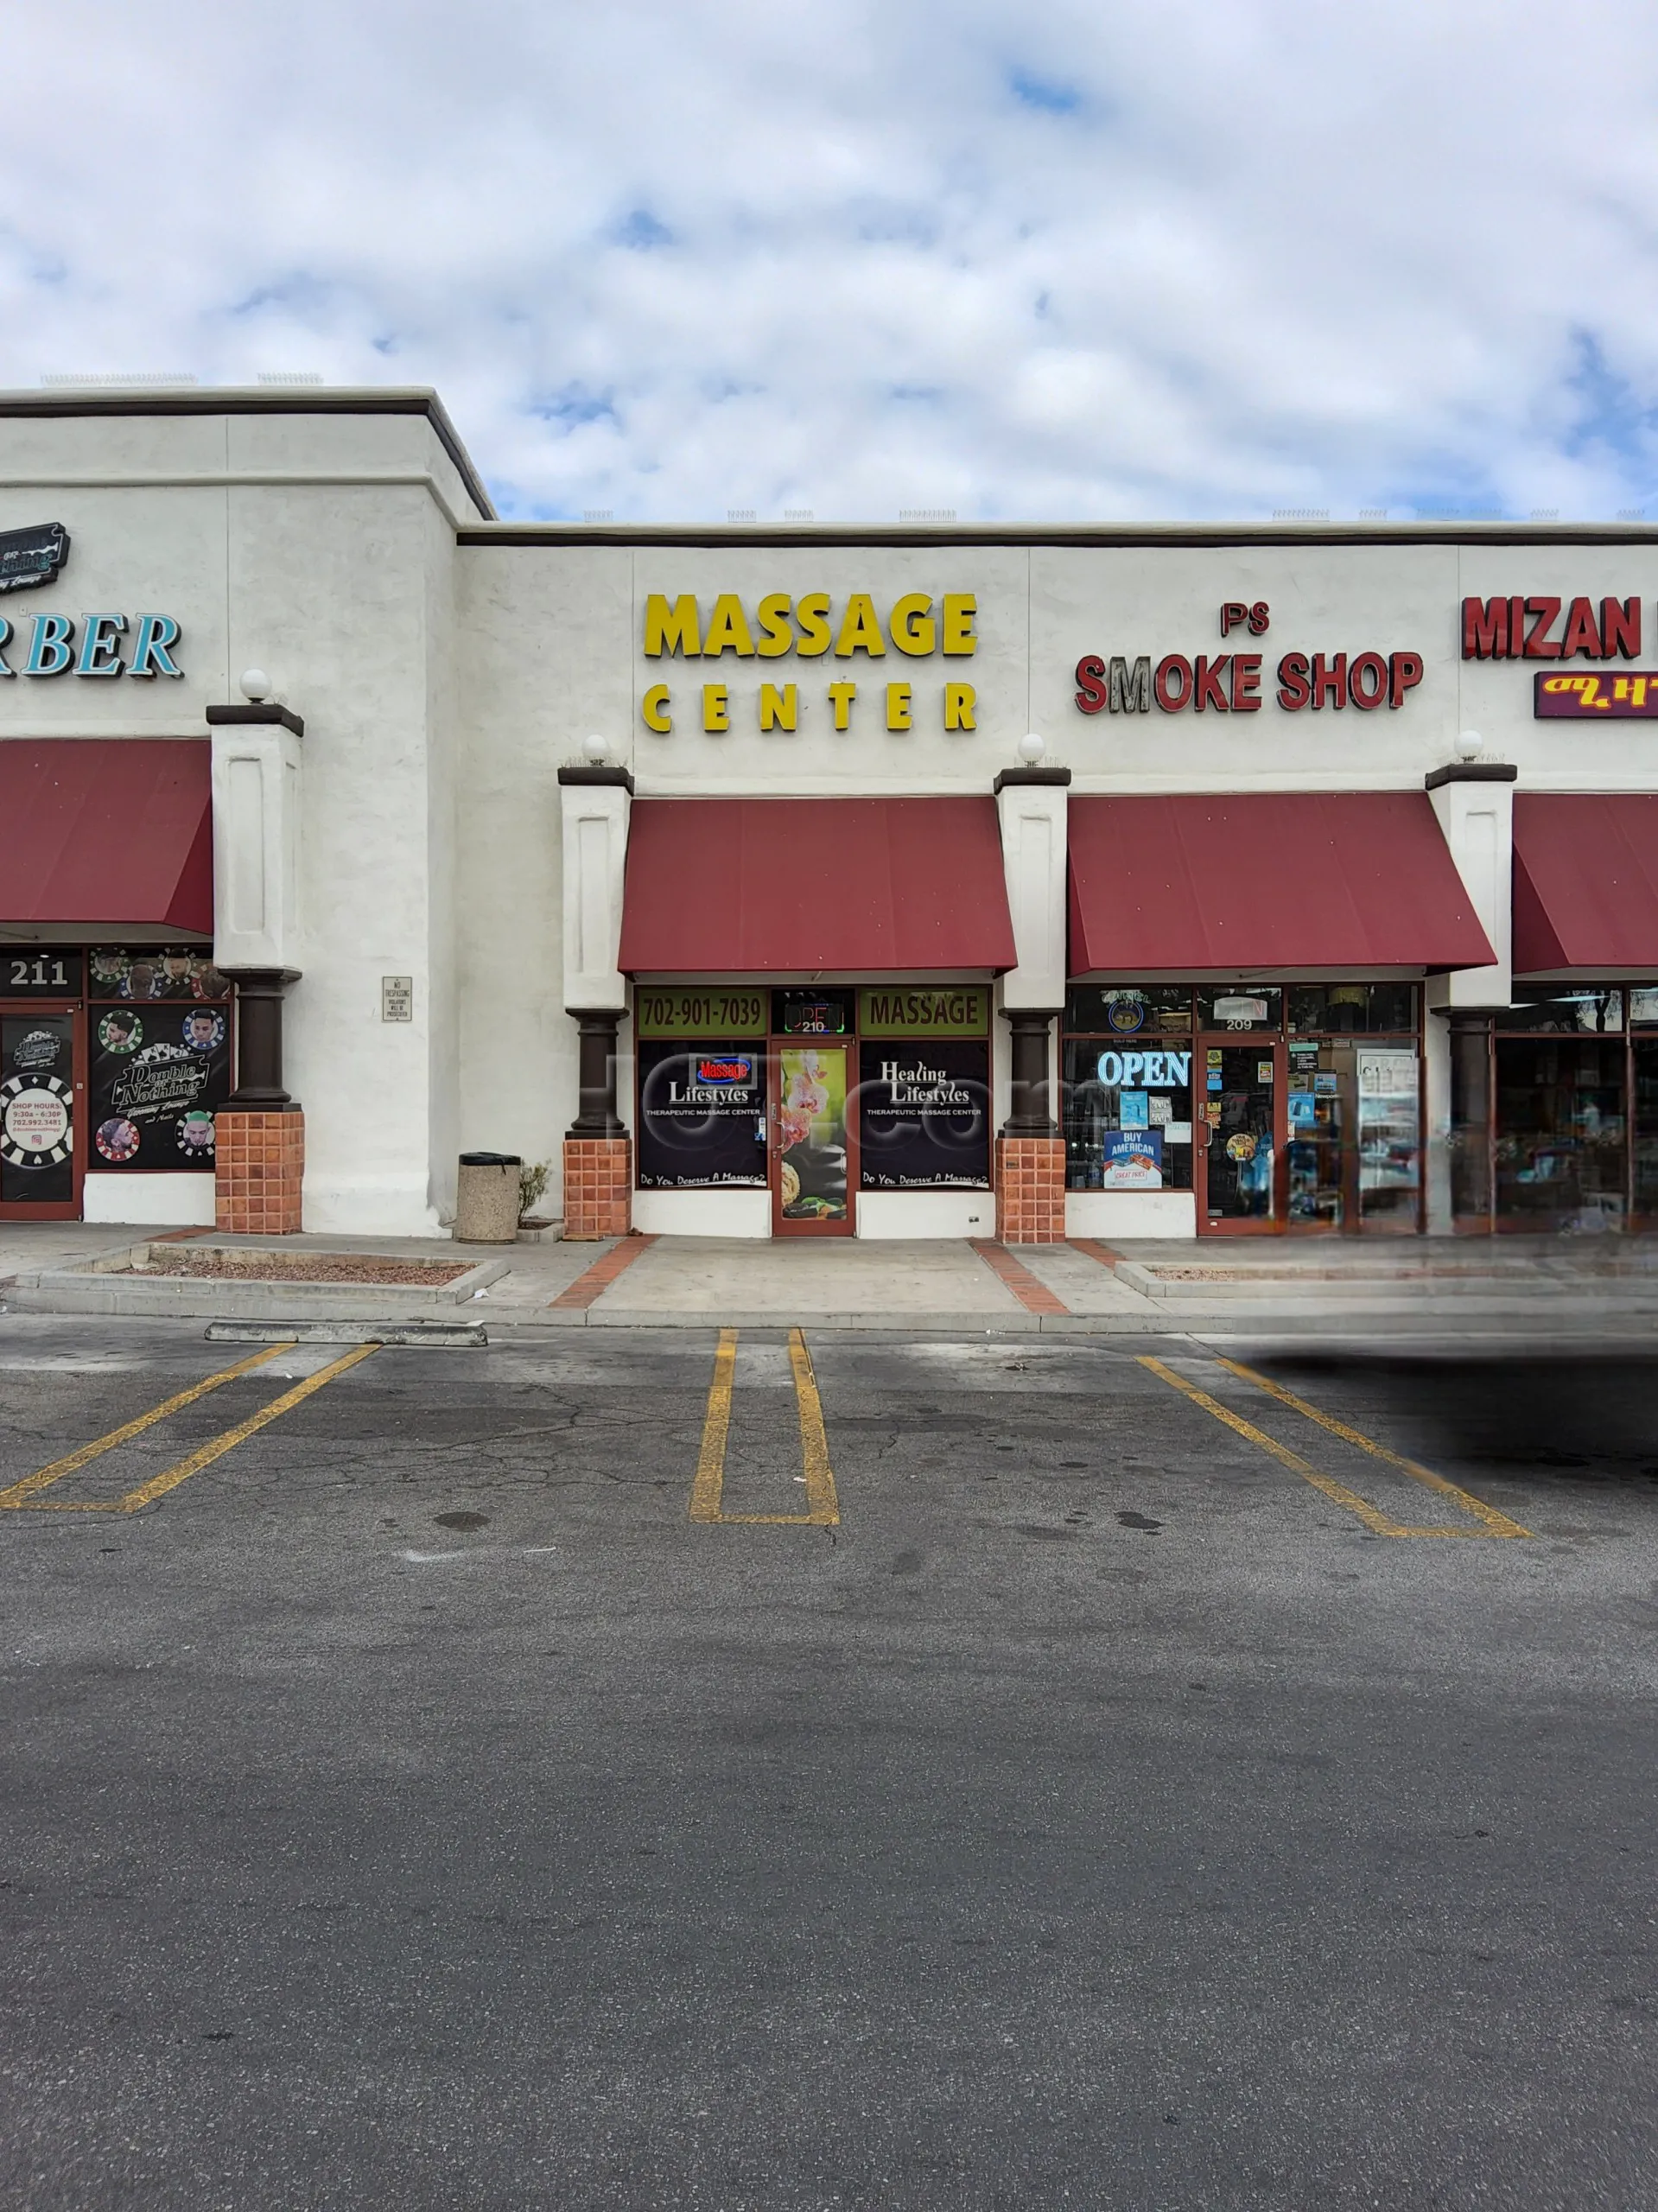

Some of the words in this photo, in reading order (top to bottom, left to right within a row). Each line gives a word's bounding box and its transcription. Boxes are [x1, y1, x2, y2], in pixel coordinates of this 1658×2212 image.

[644, 593, 978, 657] MASSAGE
[1221, 601, 1270, 637] PS
[1462, 596, 1641, 659] MIZAN
[1074, 653, 1263, 714] SMOKE
[1277, 652, 1424, 711] SHOP
[1543, 676, 1658, 709] ሚዛ
[643, 683, 977, 733] CENTER
[10, 961, 67, 984] 211
[644, 998, 760, 1026] 702-901-7039
[870, 995, 978, 1024] MASSAGE
[803, 1021, 824, 1032] 210
[1227, 1020, 1252, 1030] 209
[131, 1065, 196, 1084] Double
[701, 1061, 747, 1080] Massage
[880, 1061, 947, 1085] Healing
[1097, 1051, 1191, 1086] OPEN
[119, 1082, 200, 1105] Nothing
[669, 1081, 748, 1105] Lifestyles
[890, 1081, 969, 1105] Lifestyles
[1123, 1132, 1142, 1141] BUY
[1111, 1143, 1154, 1156] AMERICAN
[641, 1173, 653, 1185] Do
[657, 1174, 674, 1185] You
[677, 1176, 709, 1185] Deserve
[722, 1172, 765, 1183] Massage?
[863, 1172, 875, 1183] Do
[879, 1173, 896, 1184] You
[899, 1175, 932, 1184] Deserve
[935, 1173, 941, 1182] A
[944, 1173, 988, 1185] Massage?
